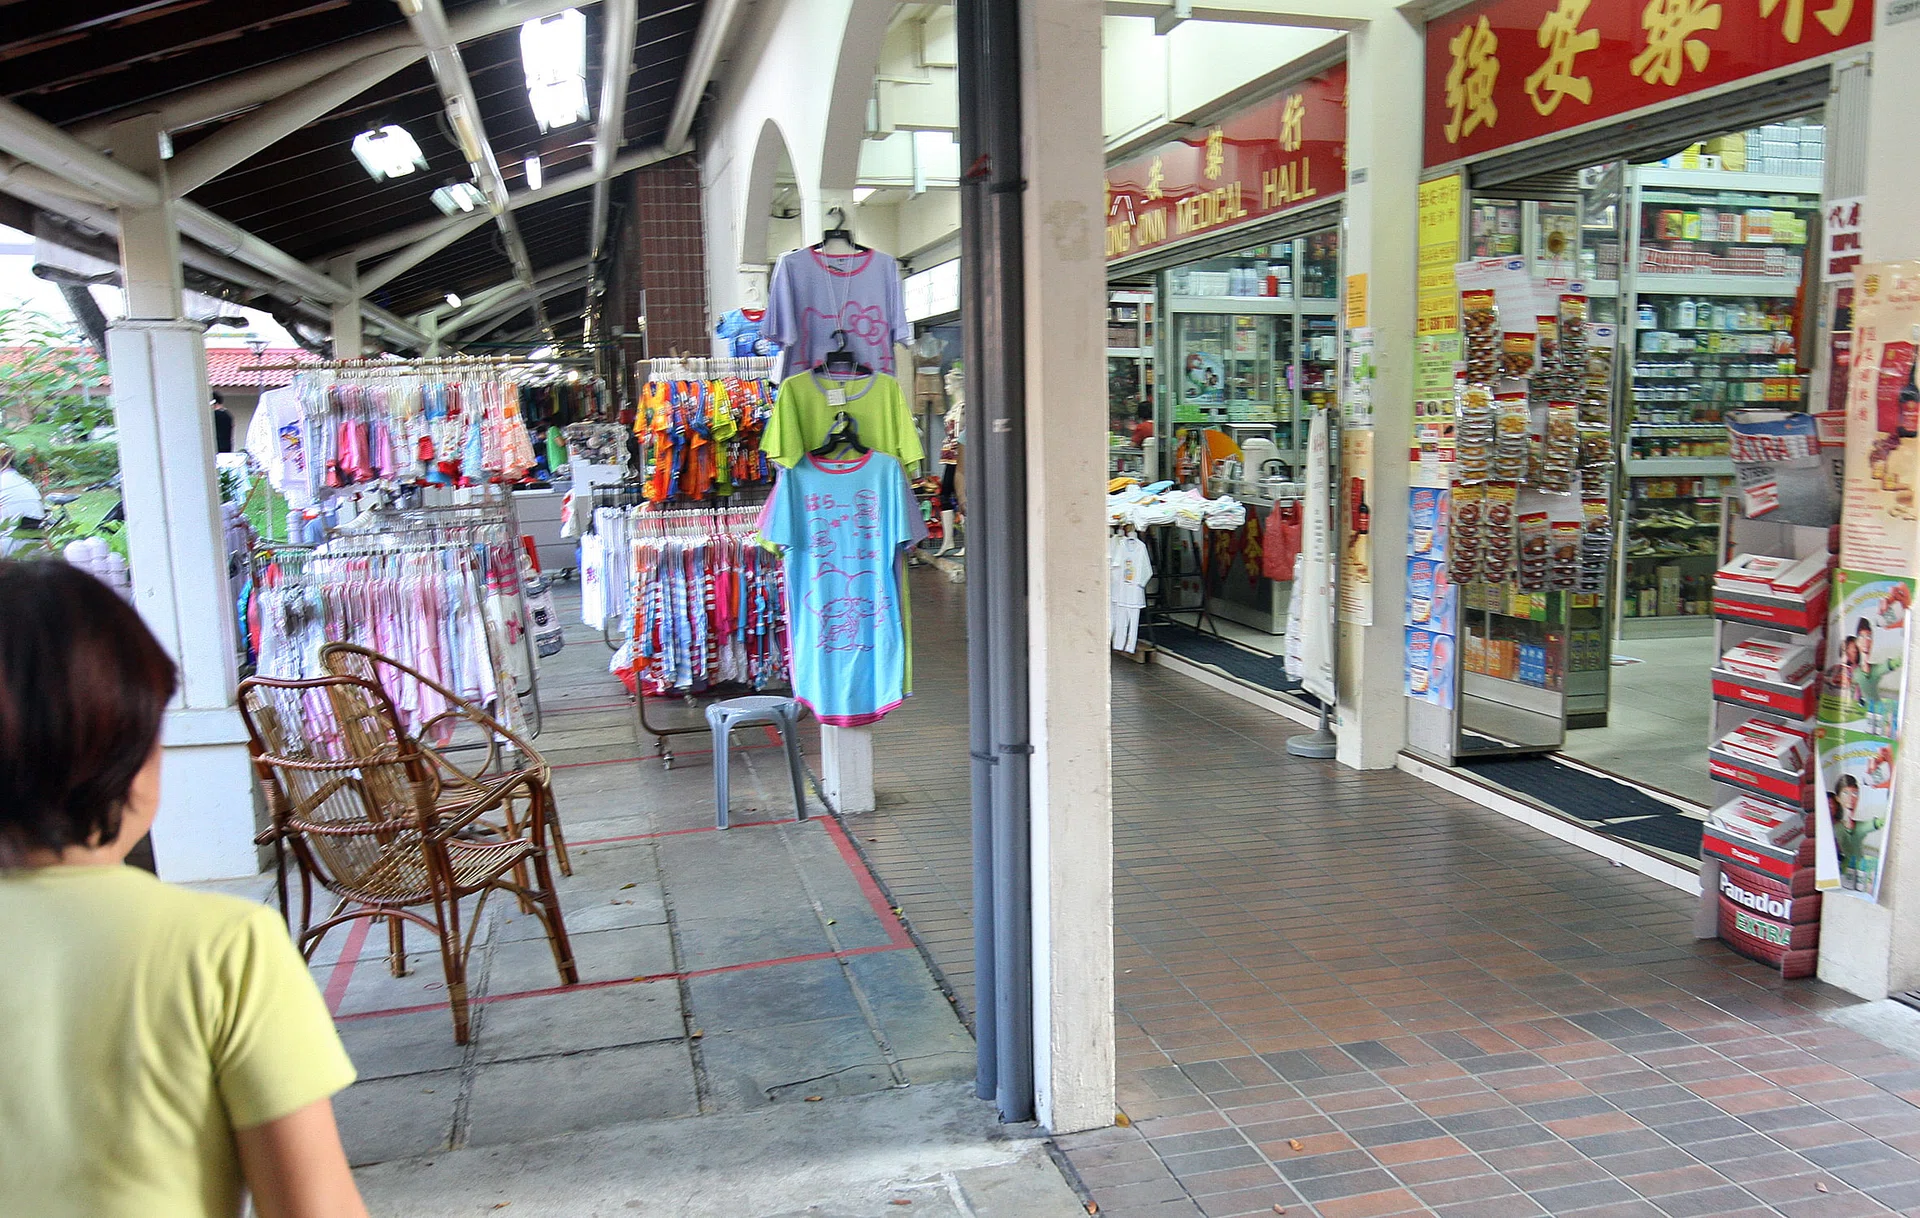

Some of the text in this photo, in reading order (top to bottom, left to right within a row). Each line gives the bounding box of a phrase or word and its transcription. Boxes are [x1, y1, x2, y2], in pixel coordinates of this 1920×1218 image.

[1176, 181, 1247, 235] MEDICAL
[1262, 156, 1317, 210] HALL
[1719, 871, 1793, 920] Panadol
[1734, 911, 1792, 947] EXTRA
